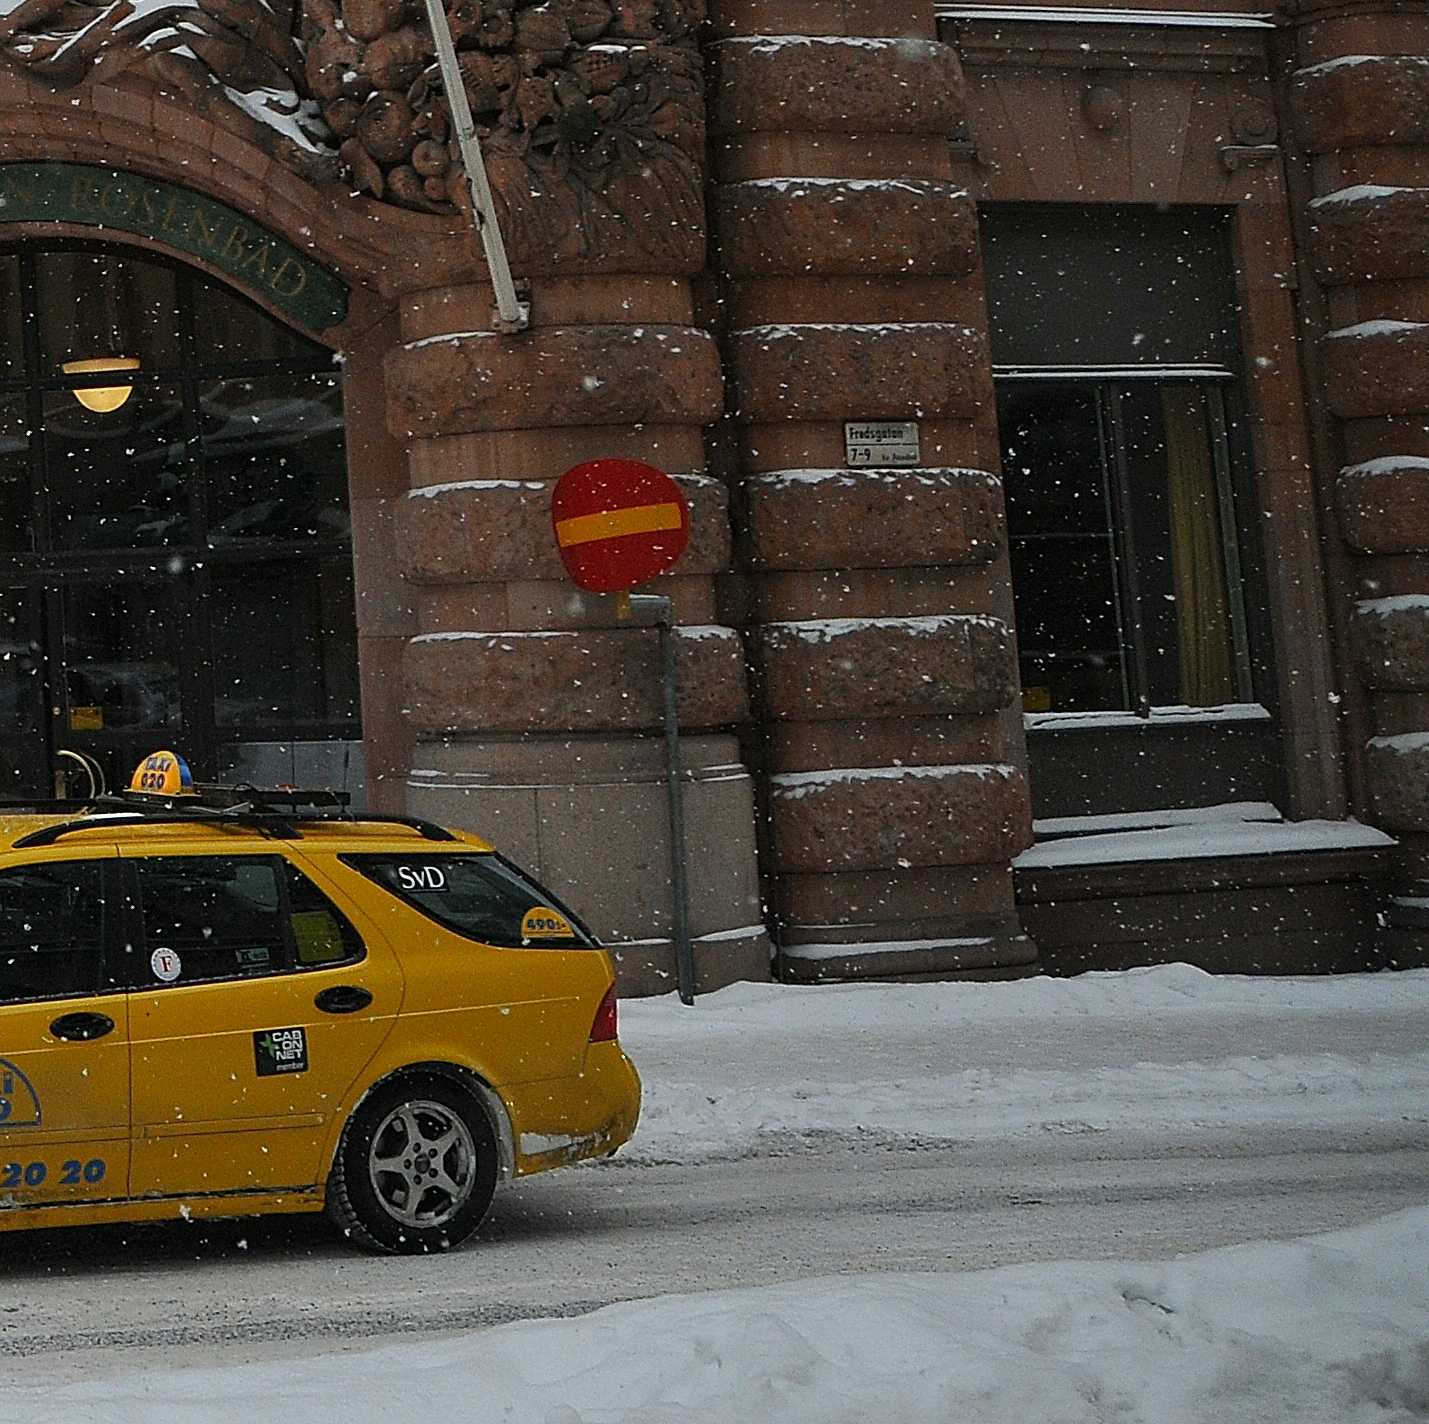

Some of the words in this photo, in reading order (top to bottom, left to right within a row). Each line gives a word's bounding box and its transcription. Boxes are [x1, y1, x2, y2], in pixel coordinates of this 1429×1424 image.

[71, 176, 309, 298] ROSENBAD
[849, 426, 904, 443] Fredsgatan
[851, 448, 871, 461] 7-9
[141, 773, 165, 789] 020
[398, 866, 445, 889] SvD
[159, 955, 172, 972] F
[272, 1030, 302, 1042] CAB
[282, 1039, 303, 1051] ON
[275, 1049, 302, 1061] NET
[0, 1161, 47, 1188] 20
[59, 1158, 106, 1184] 20
